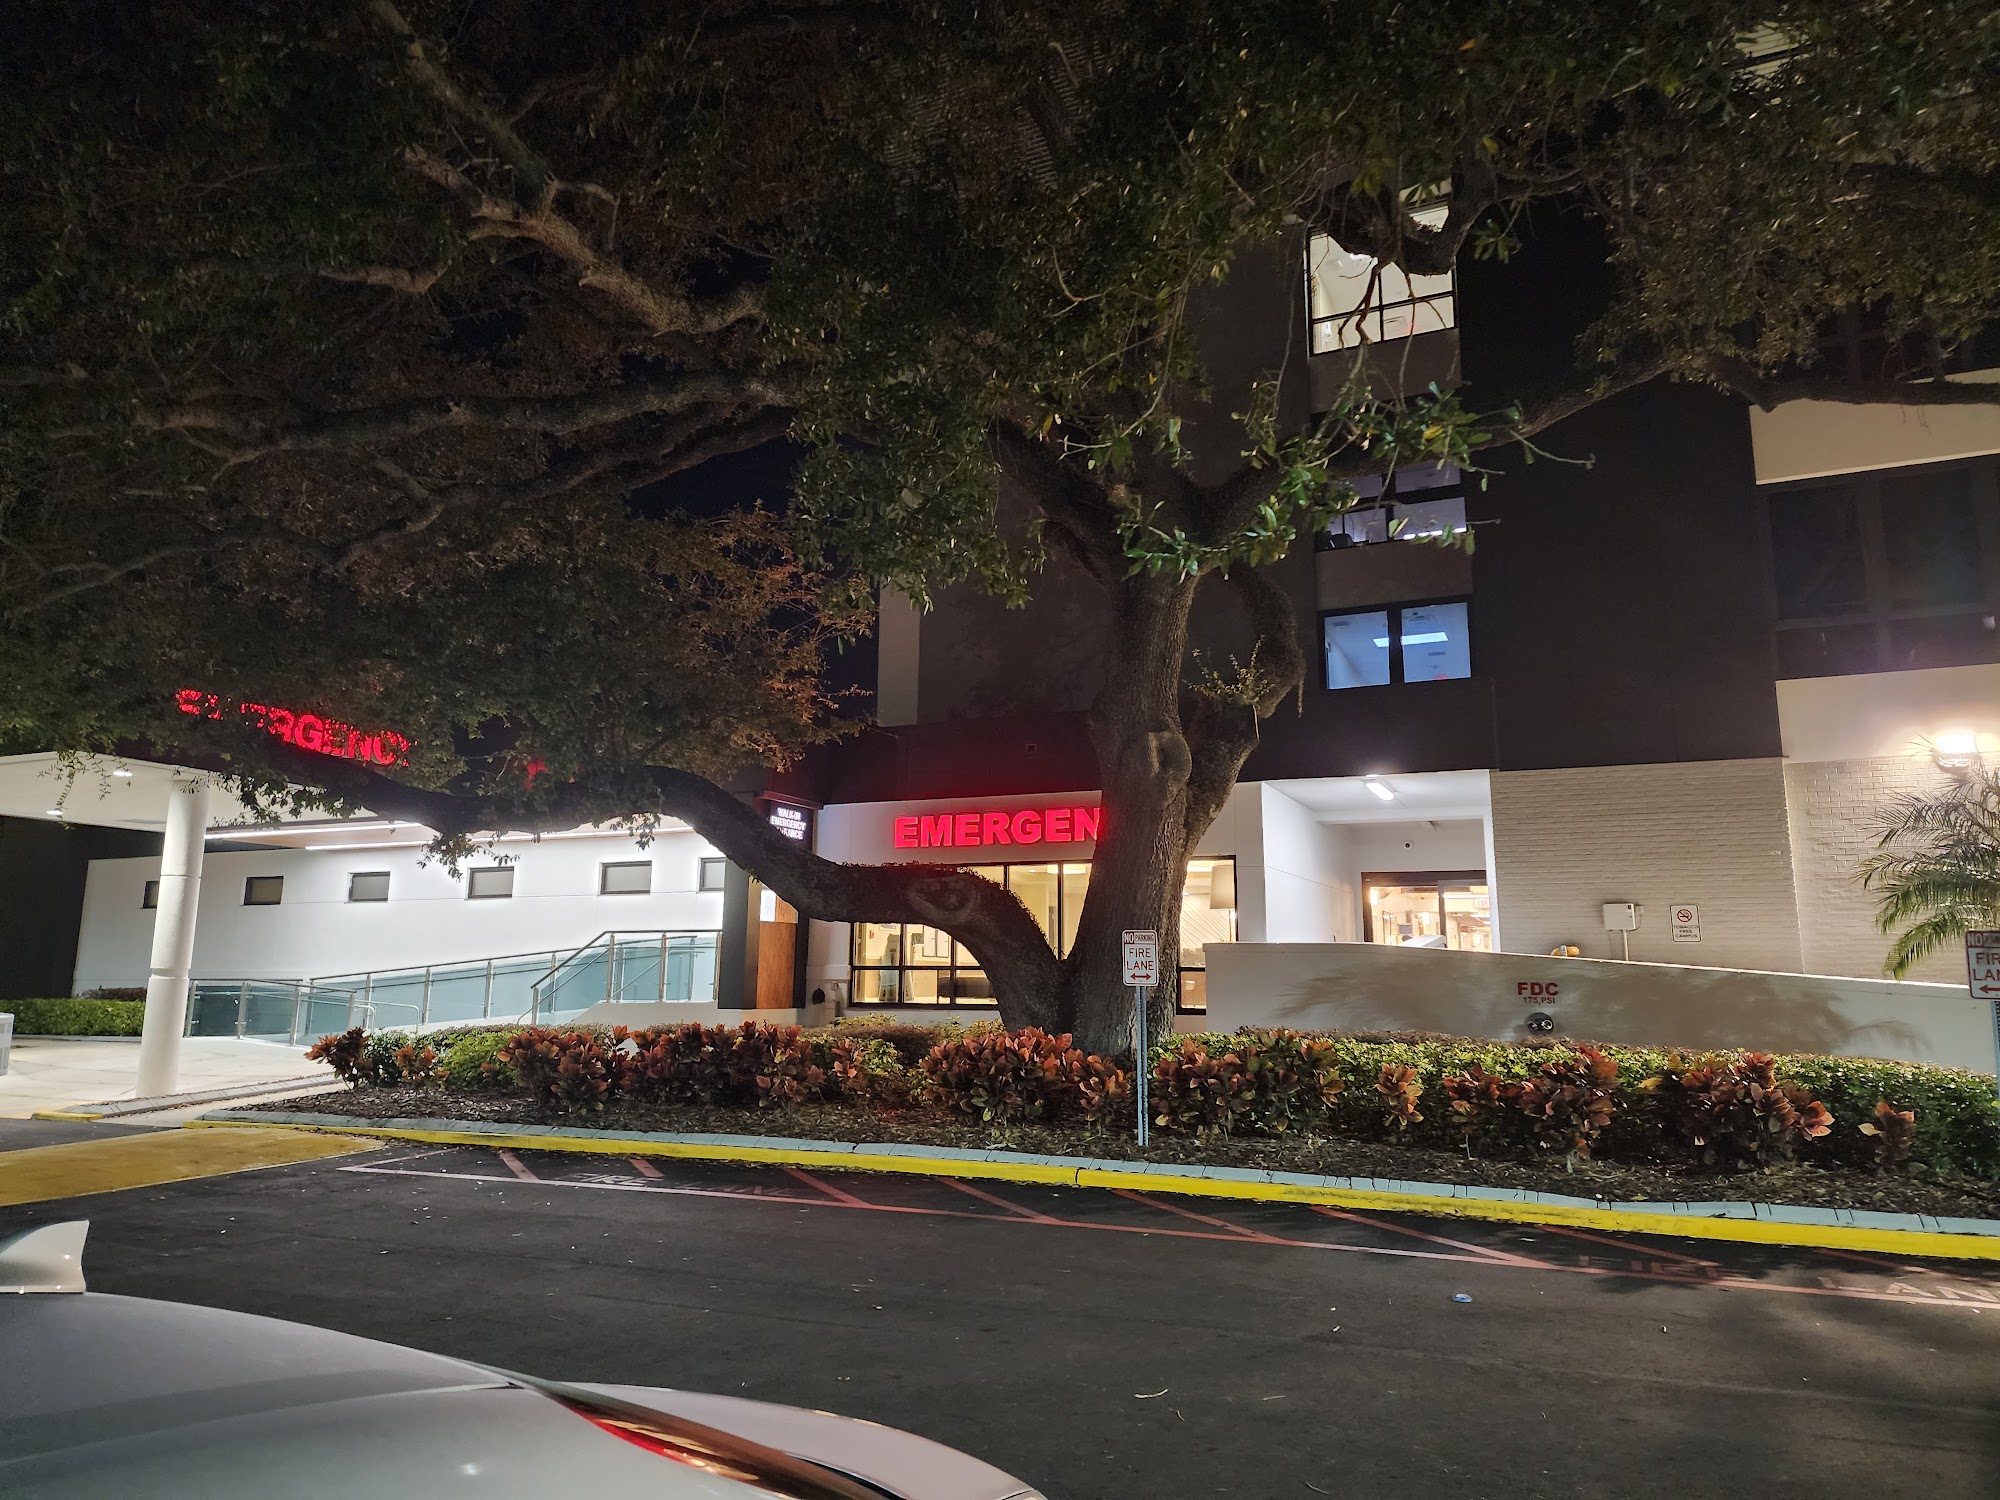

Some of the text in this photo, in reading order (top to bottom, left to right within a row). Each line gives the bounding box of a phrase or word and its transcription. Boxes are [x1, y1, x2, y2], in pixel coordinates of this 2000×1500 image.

[769, 815, 807, 831] EMERGENCY
[1125, 932, 1134, 943] NO
[1967, 933, 1983, 946] NO
[1129, 948, 1151, 957] FIRE
[1126, 960, 1154, 970] LANE
[1517, 982, 1560, 996] FDC
[1523, 996, 1556, 1004] 175 PSI
[553, 1173, 664, 1187] FIRE
[1817, 1276, 2000, 1301] LAN
